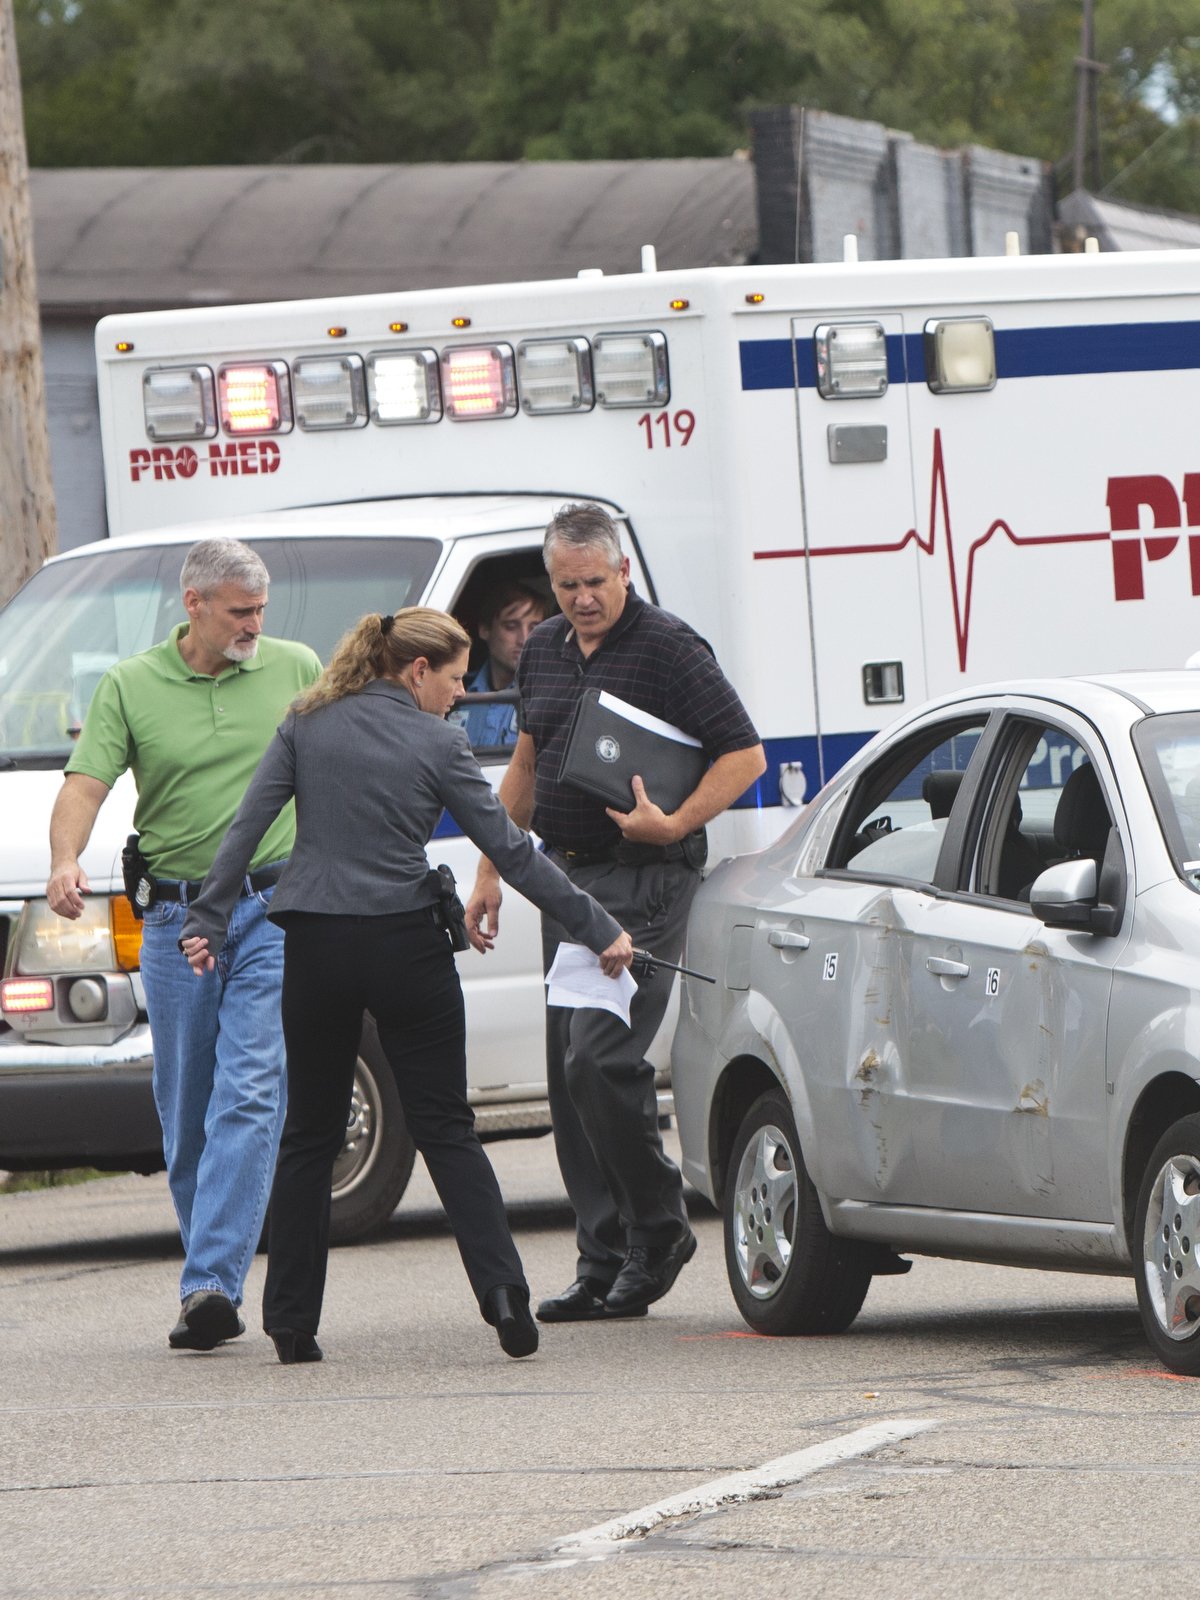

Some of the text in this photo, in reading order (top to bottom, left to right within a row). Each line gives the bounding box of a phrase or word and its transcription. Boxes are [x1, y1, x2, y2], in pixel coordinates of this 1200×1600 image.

[638, 409, 695, 449] 119
[129, 440, 281, 481] PRO MED
[825, 955, 837, 979] 15
[988, 970, 999, 994] 16
